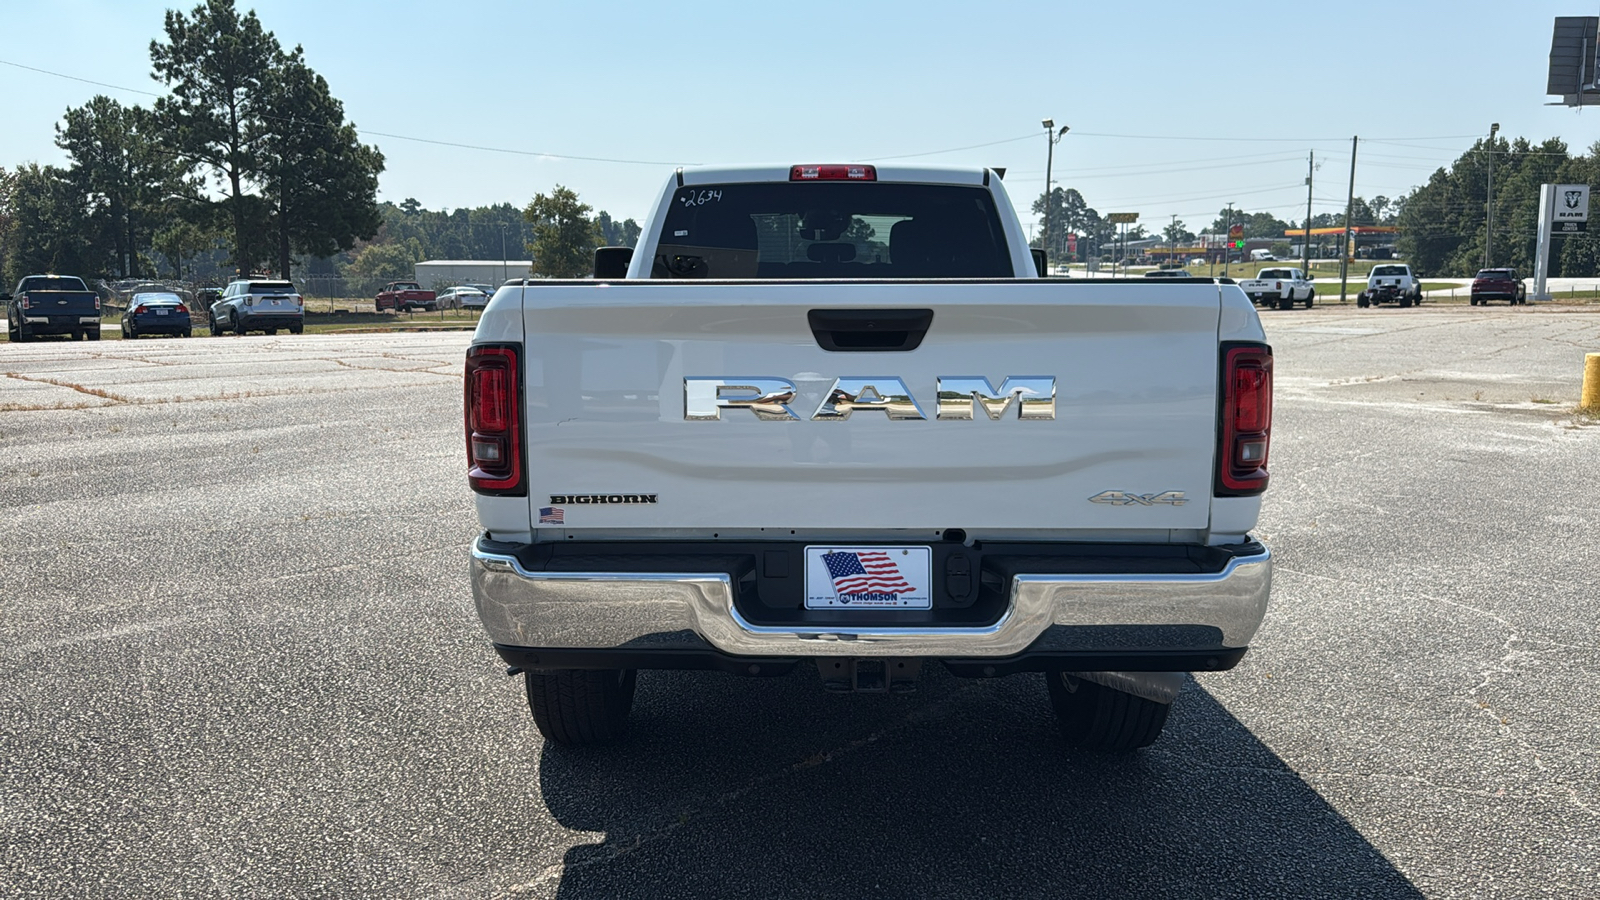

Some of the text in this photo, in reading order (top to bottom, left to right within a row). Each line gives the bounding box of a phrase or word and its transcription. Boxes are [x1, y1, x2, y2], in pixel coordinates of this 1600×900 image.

[685, 190, 722, 207] 2634
[683, 376, 1056, 421] RAM
[550, 494, 658, 505] BIGHORN
[851, 593, 898, 601] THOMSON
